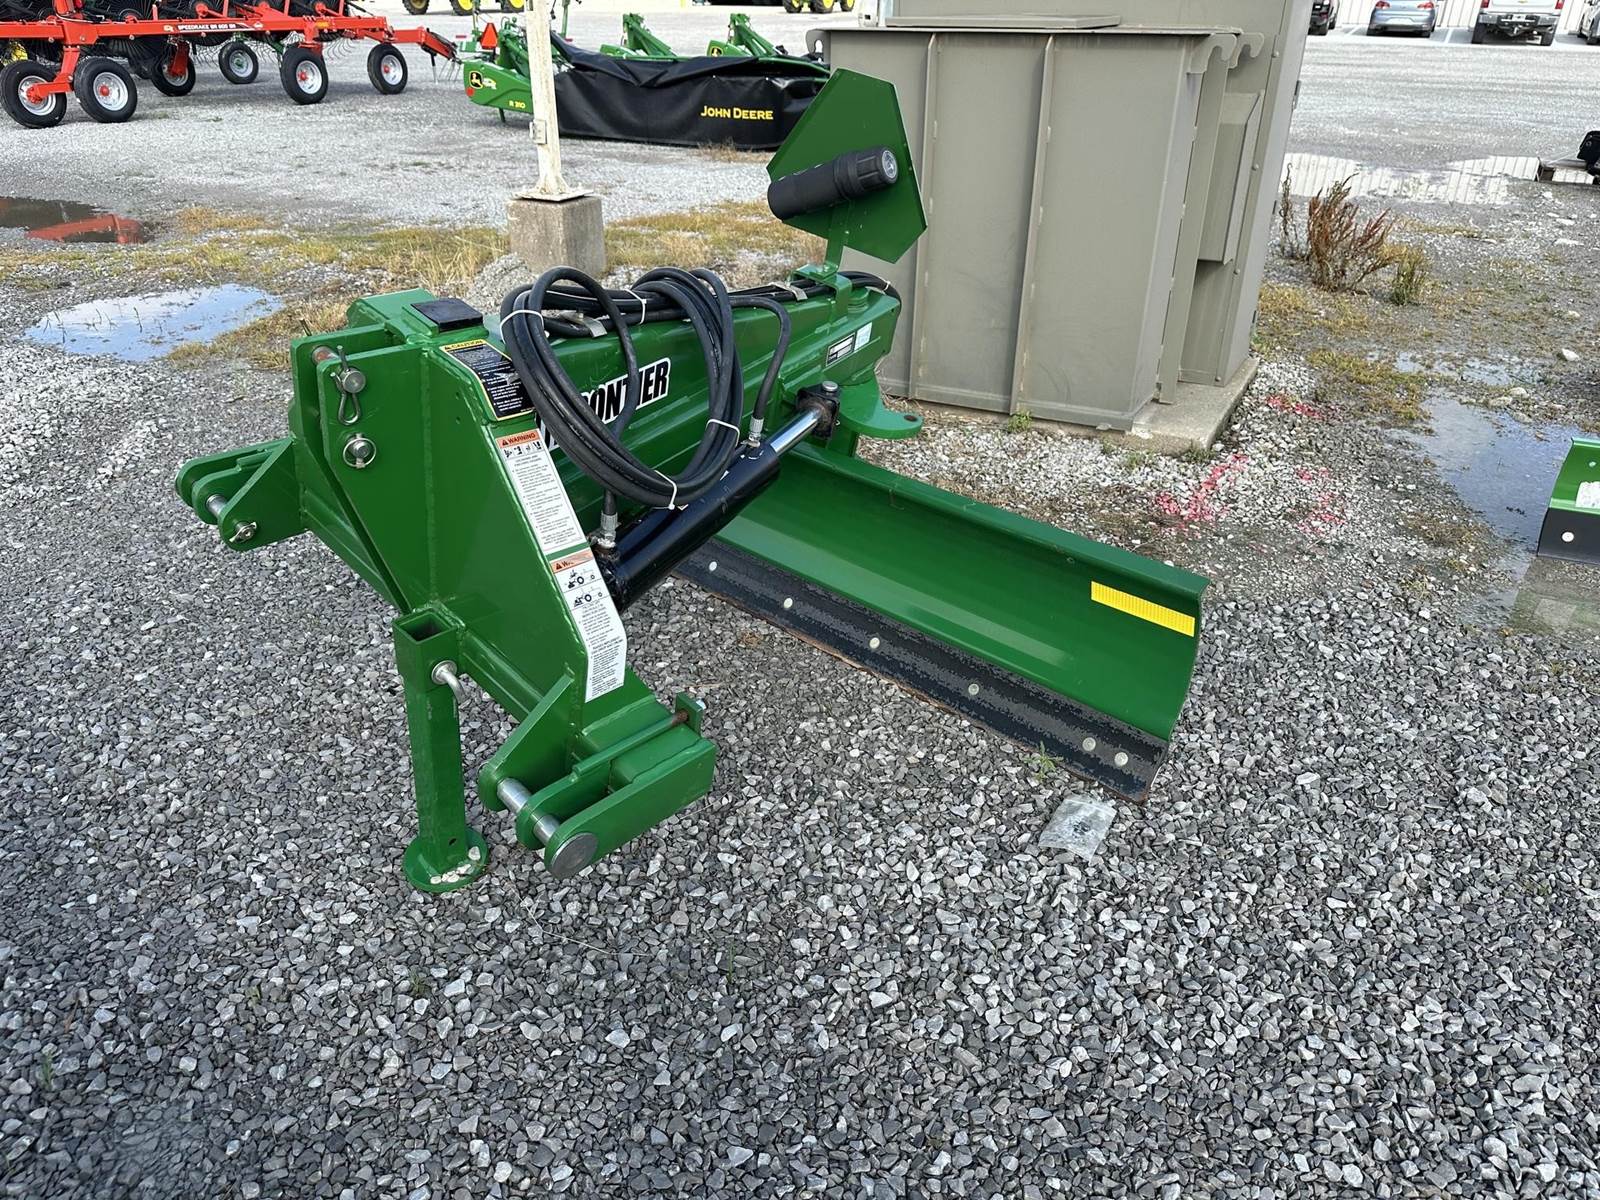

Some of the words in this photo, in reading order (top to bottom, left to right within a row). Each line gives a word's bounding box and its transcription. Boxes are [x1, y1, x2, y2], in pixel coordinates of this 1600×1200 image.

[701, 105, 731, 118] JOHN
[733, 107, 774, 120] DEERE
[507, 432, 536, 445] WARNING
